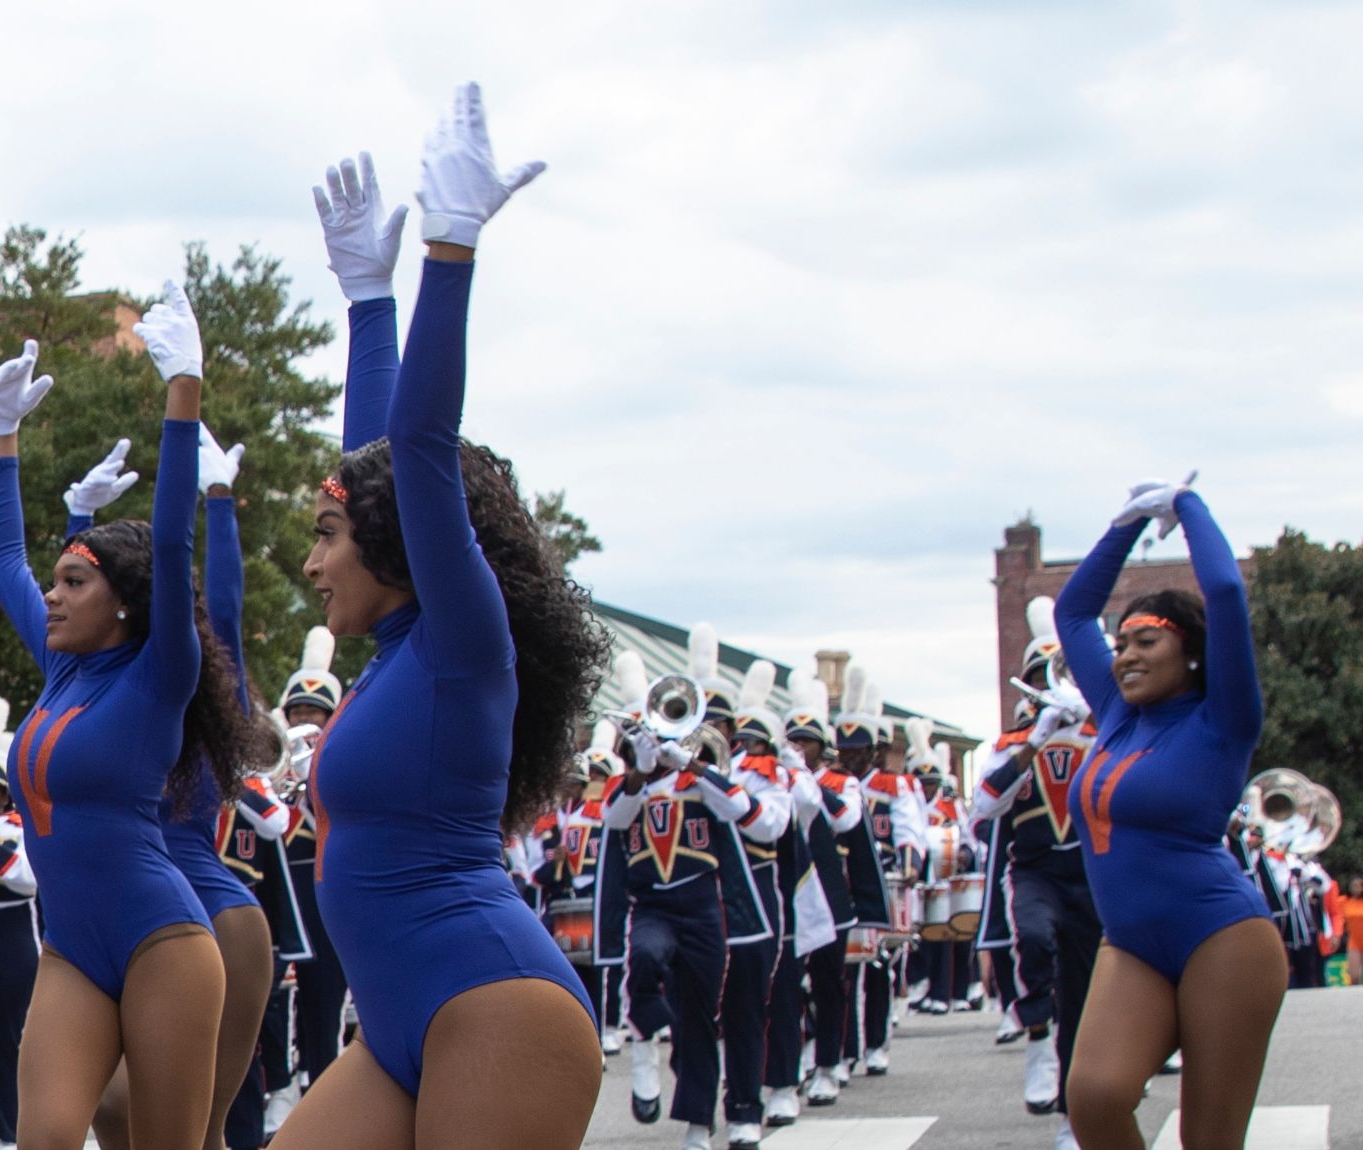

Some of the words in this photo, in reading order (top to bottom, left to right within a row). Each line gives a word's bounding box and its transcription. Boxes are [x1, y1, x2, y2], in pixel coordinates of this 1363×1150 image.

[18, 705, 90, 837] V
[1044, 749, 1074, 784] V
[648, 800, 673, 837] V
[686, 819, 710, 848] U
[1081, 745, 1151, 855] V
[236, 829, 256, 859] U
